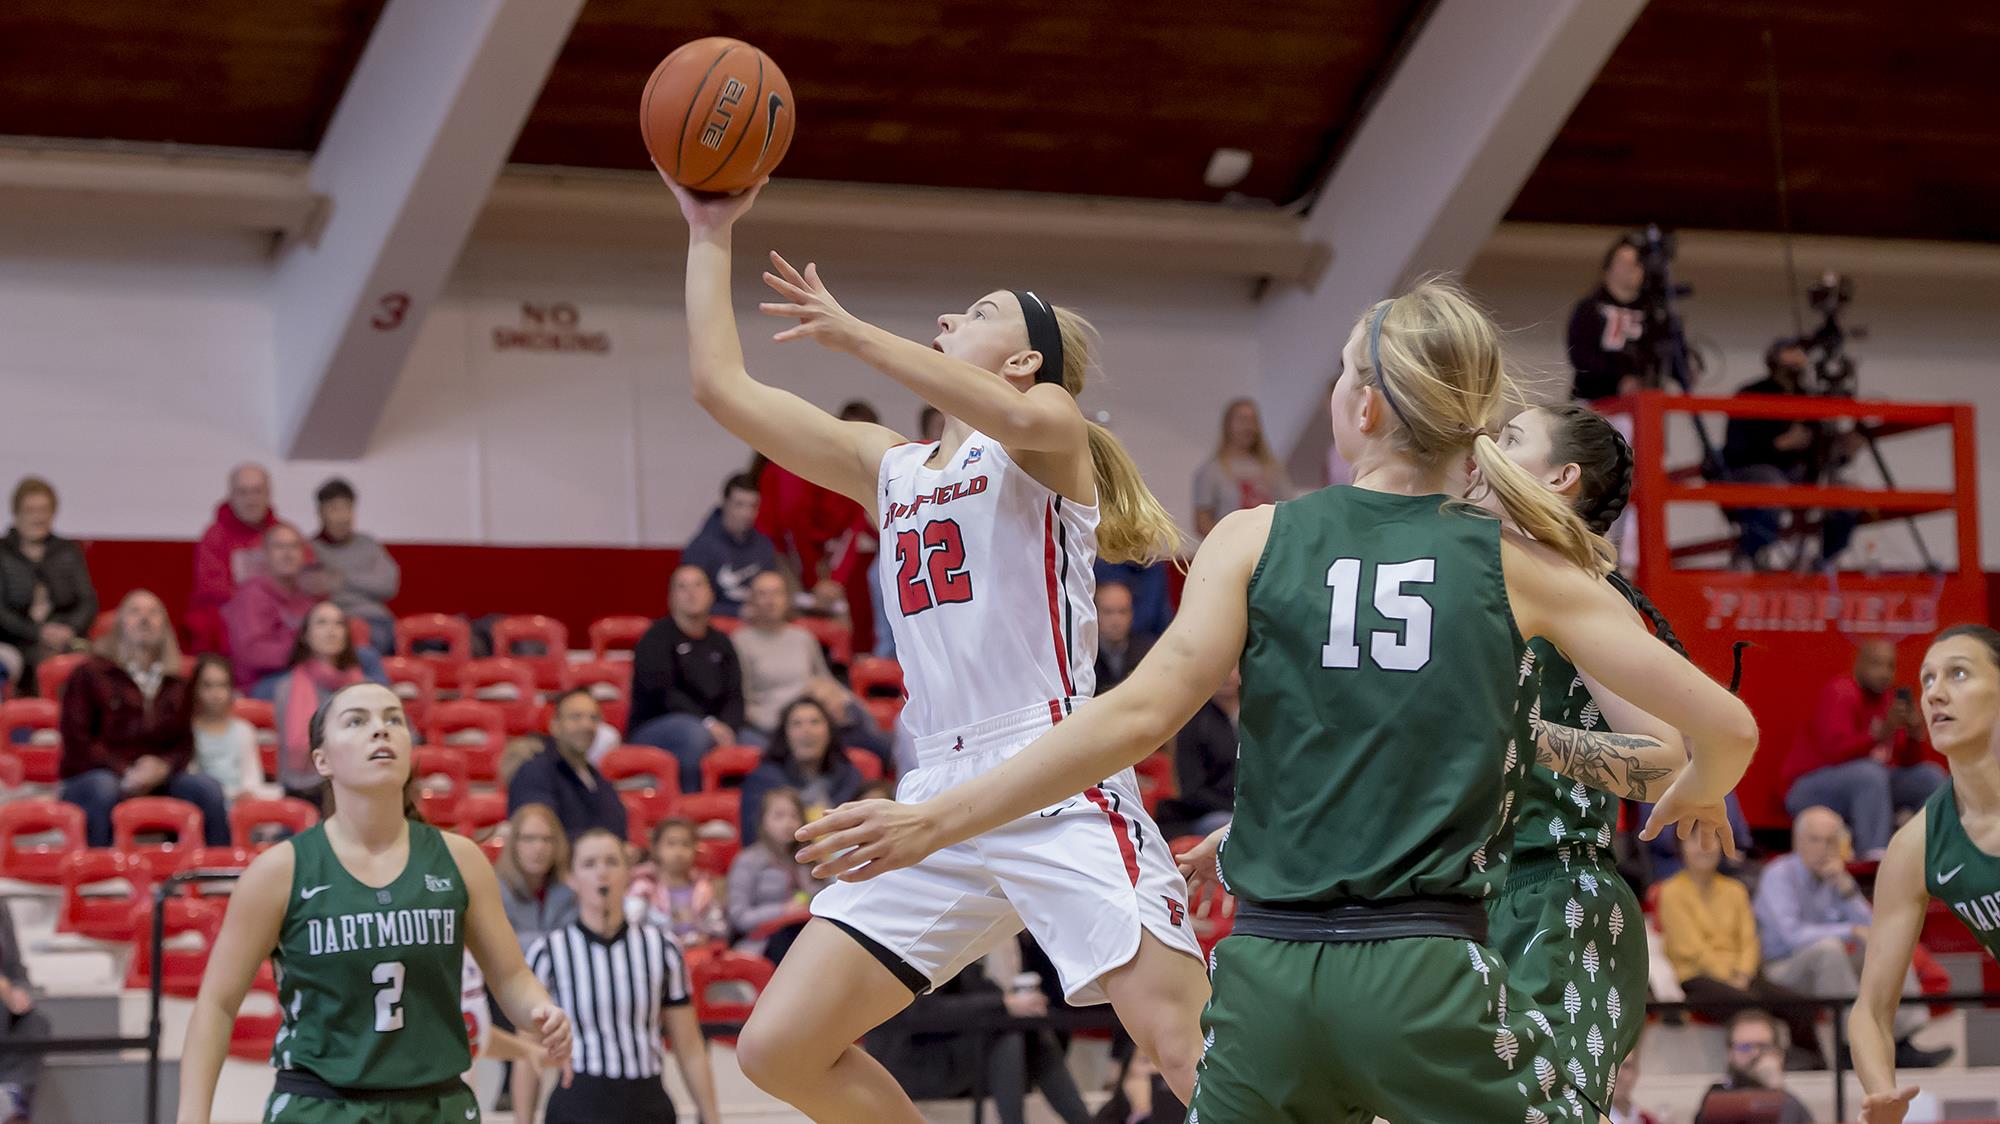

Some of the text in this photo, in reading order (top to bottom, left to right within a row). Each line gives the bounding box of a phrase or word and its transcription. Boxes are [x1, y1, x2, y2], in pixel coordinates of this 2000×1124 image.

[700, 77, 747, 151] ELITE
[371, 290, 411, 332] 3
[521, 302, 579, 327] NO
[493, 328, 610, 354] SMOKING
[883, 475, 989, 530] AIFIELD
[895, 517, 973, 618] 22
[1321, 557, 1437, 673] 15
[1703, 586, 1938, 633] FAIRFIELD
[307, 908, 457, 956] DARTMOUTH
[371, 960, 407, 1034] 2
